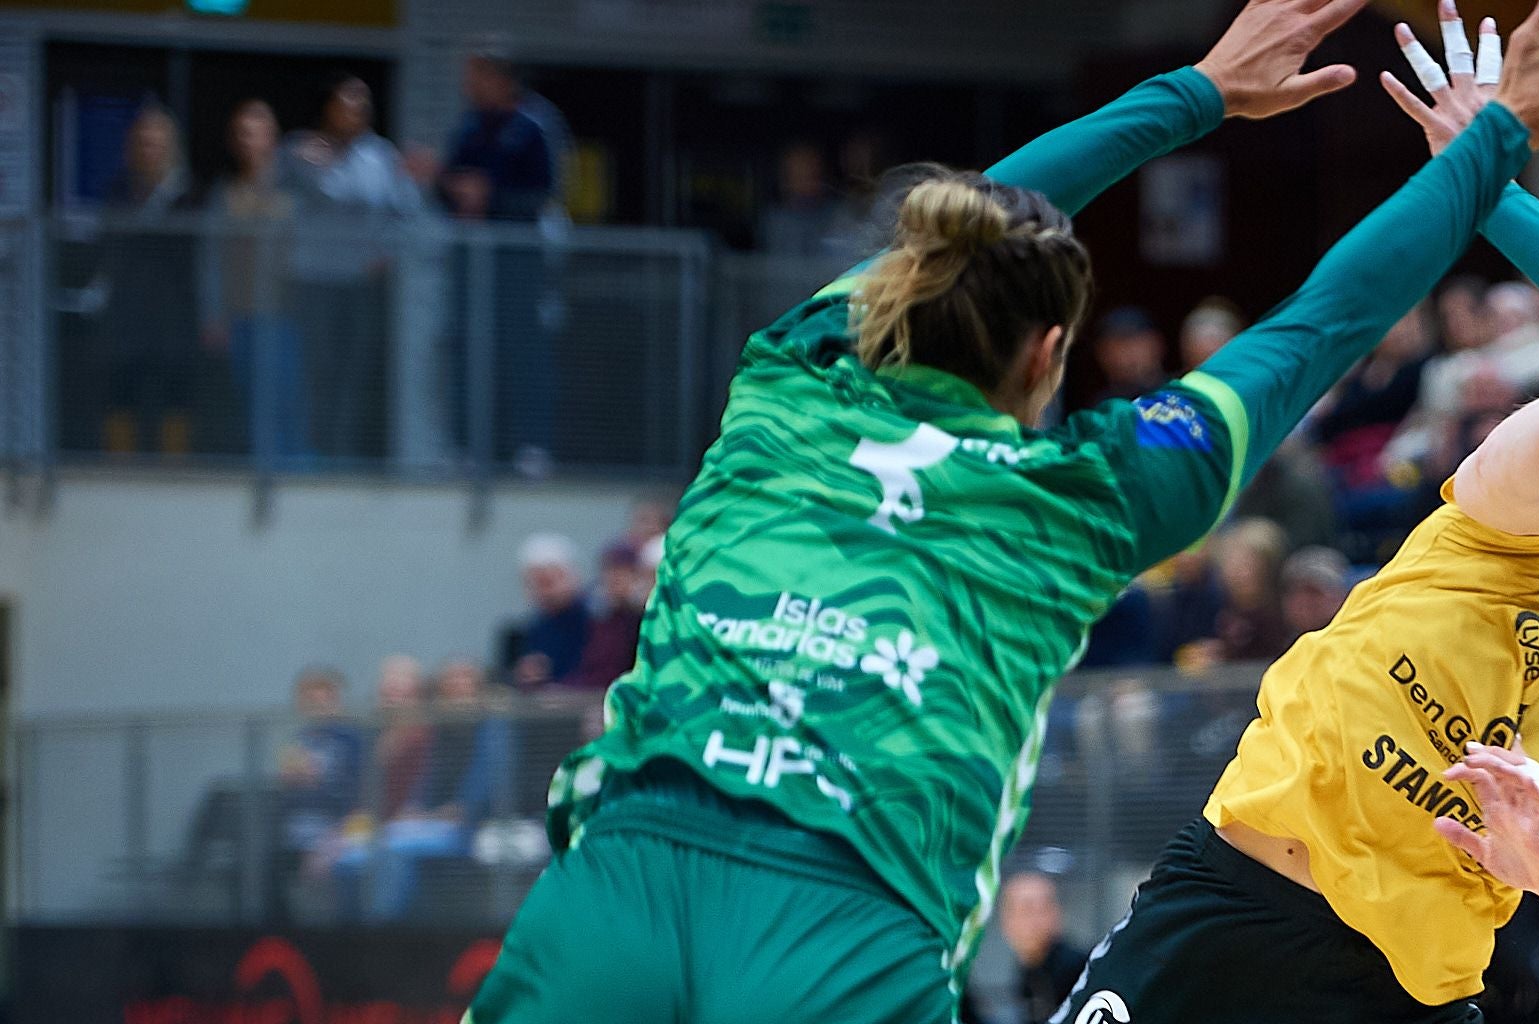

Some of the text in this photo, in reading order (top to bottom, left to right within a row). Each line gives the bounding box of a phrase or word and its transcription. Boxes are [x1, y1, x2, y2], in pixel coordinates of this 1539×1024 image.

[773, 590, 868, 641] Islas
[1388, 654, 1446, 726] Den
[1428, 728, 1463, 766] Sand
[1362, 734, 1487, 832] STANGE
